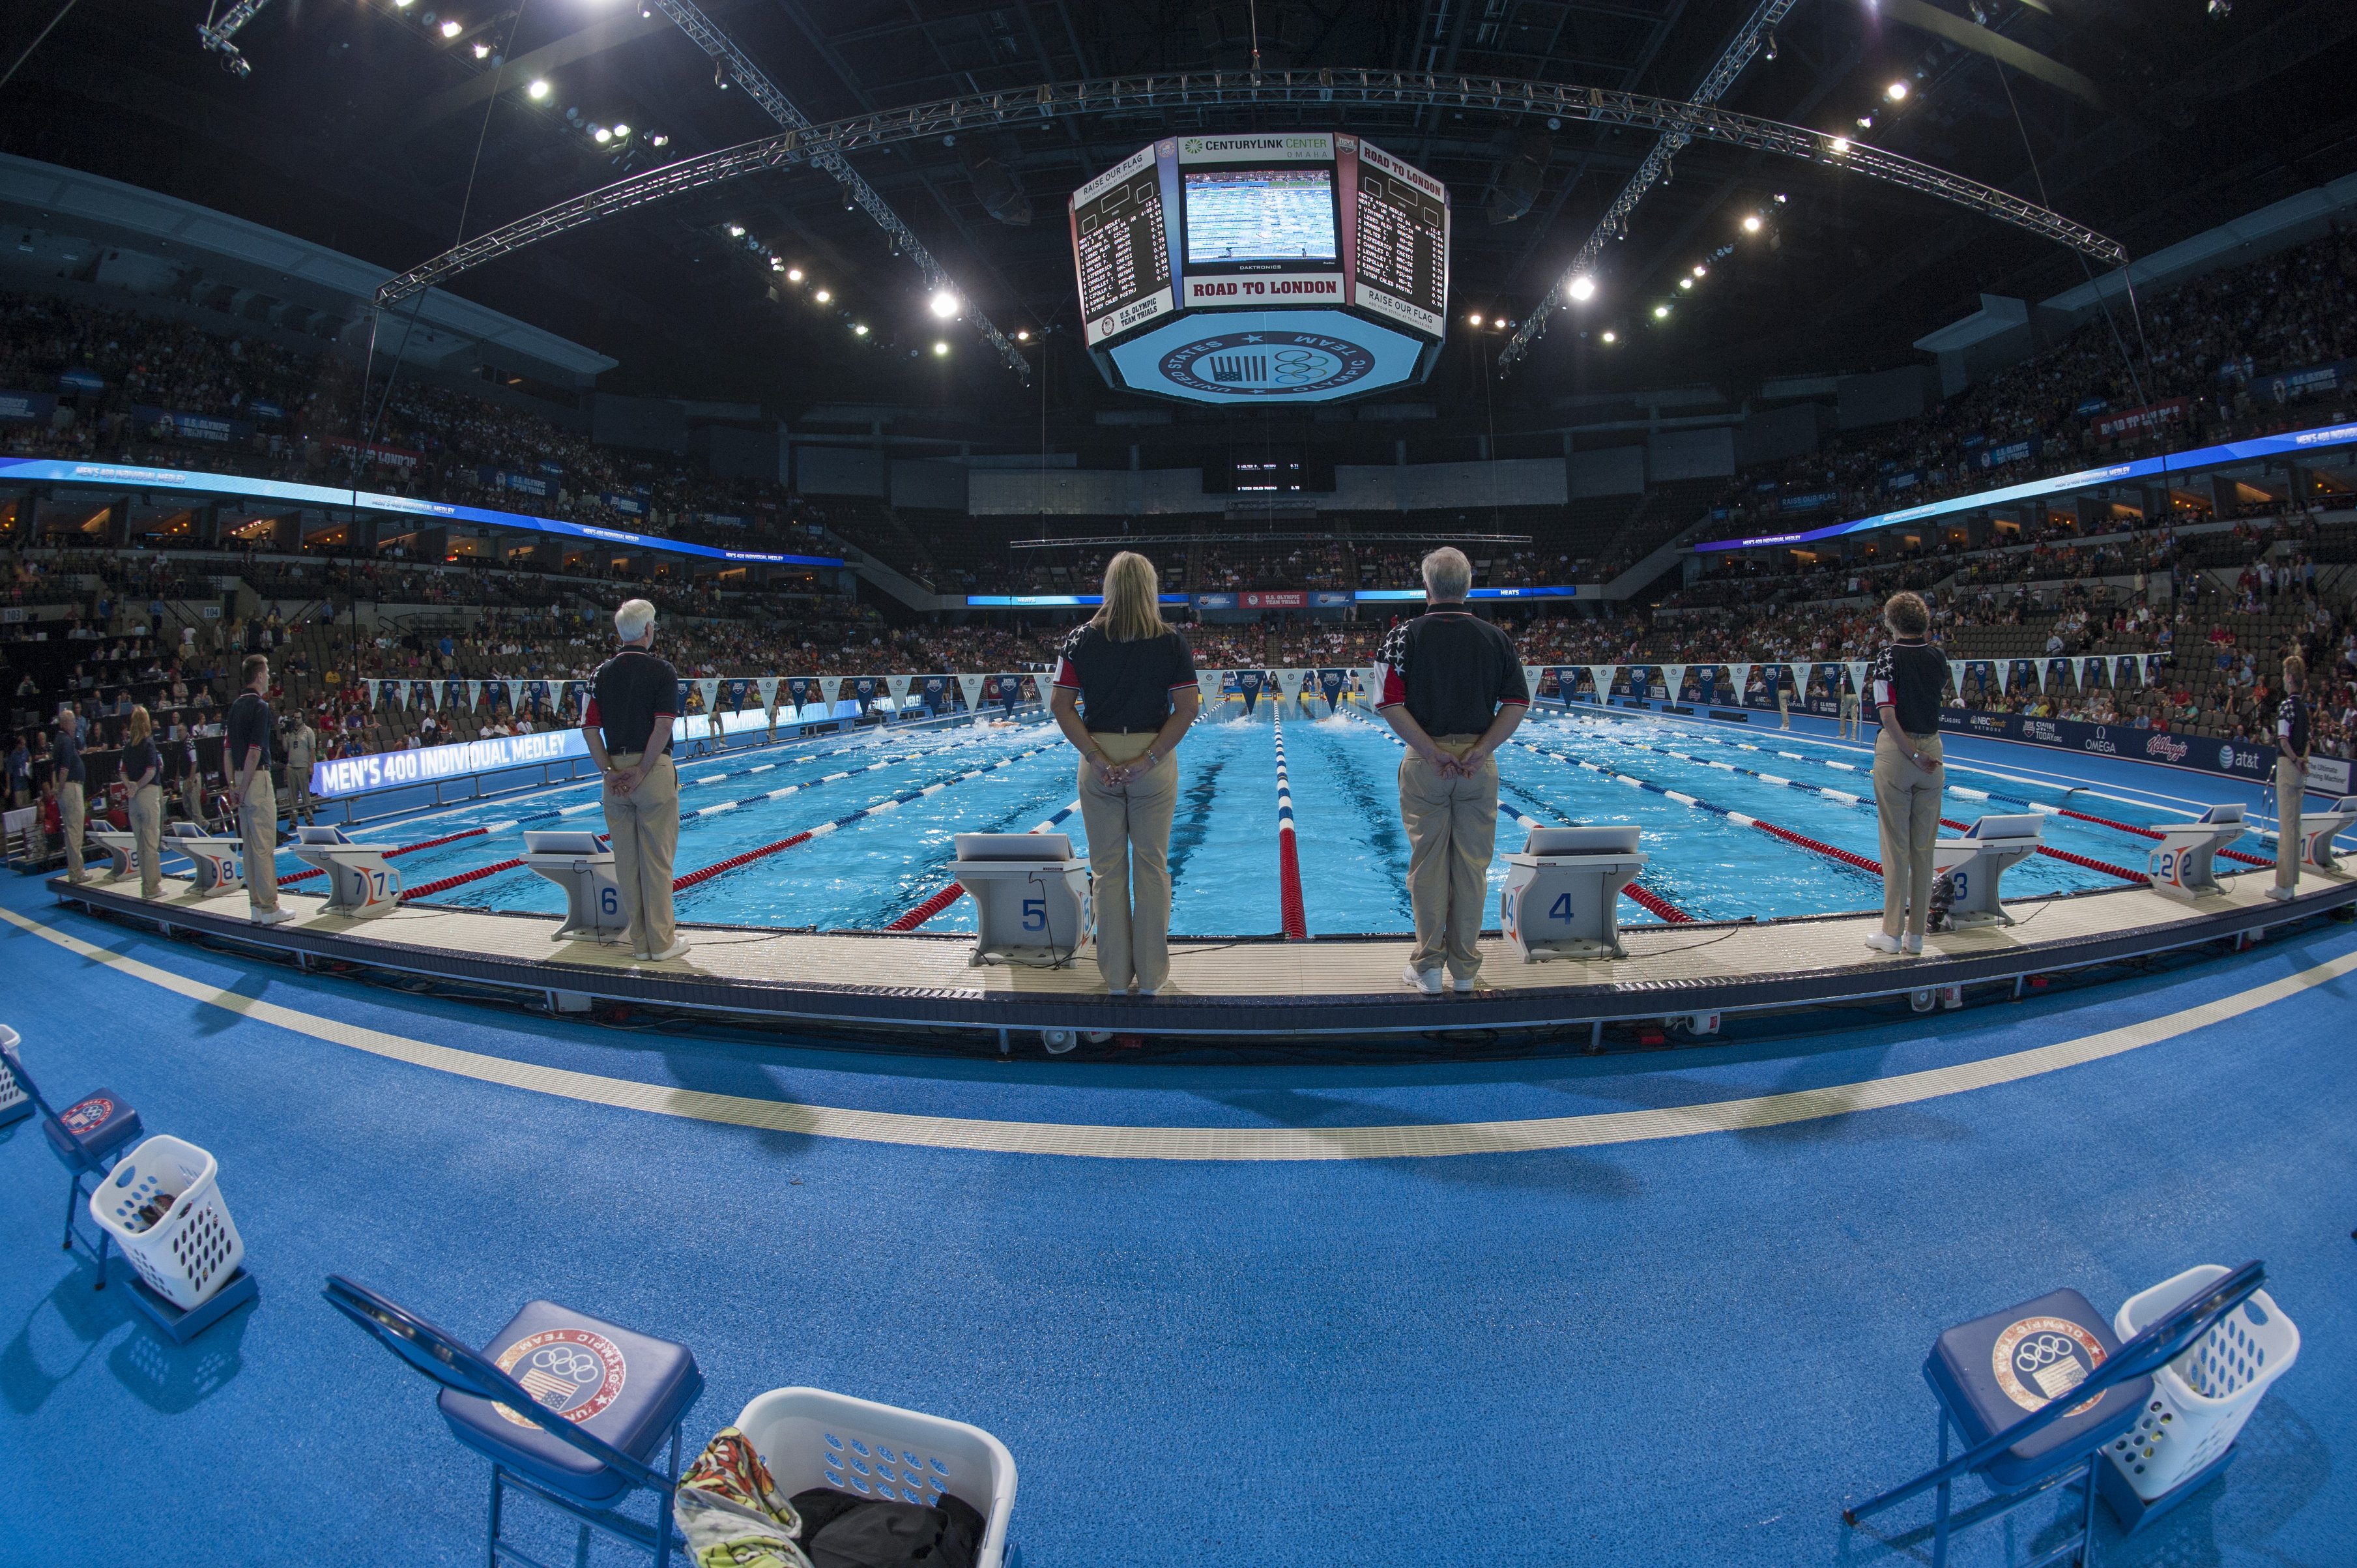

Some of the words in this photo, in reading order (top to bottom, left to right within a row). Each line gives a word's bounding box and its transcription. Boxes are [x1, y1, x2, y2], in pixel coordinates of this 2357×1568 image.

[1286, 138, 1327, 149] CENTER
[1083, 177, 1103, 195] RAISE
[1106, 168, 1121, 181] OUR
[1123, 154, 1142, 171] FLAG
[1365, 147, 1389, 168] ROAD
[1392, 161, 1404, 177] TO
[1407, 169, 1441, 197] LONDON
[1358, 197, 1370, 207] HEAT
[1358, 191, 1373, 202] MEN'S
[1389, 206, 1406, 218] MEDLEY
[1381, 221, 1392, 231] ALEX
[1193, 283, 1237, 297] ROAD
[1243, 282, 1264, 295] TO
[1270, 281, 1337, 293] LONDON
[1120, 310, 1131, 319] U.S.
[1132, 297, 1157, 314] OLYMPIC
[1121, 316, 1136, 327] TEAM
[1137, 306, 1157, 320] TRIALS
[1369, 290, 1393, 307] RAISE
[1395, 301, 1411, 315] OUR
[1413, 309, 1432, 323] FLAG
[1168, 340, 1223, 370] STATES
[1294, 336, 1357, 356] TEAM
[1171, 371, 1231, 392] UNITED
[1293, 359, 1366, 392] OLYMPIC
[433, 505, 455, 515] MEDLEY
[1782, 496, 1801, 506] RAISE
[1803, 495, 1817, 503] OUR
[1819, 493, 1836, 501] FLAG
[7, 610, 20, 620] 103
[205, 608, 218, 617] 104
[1978, 716, 1990, 725] NBC
[2036, 721, 2055, 733] SWIM
[2085, 739, 2116, 753] OMEGA
[2147, 734, 2188, 761] Kellogg's
[321, 757, 381, 793] MEN'S
[383, 752, 416, 783] 400
[421, 740, 510, 777] INDIVIDUAL
[512, 733, 565, 759] MEDLEY
[2235, 752, 2259, 770] at&t
[2317, 764, 2337, 774] Ultimate
[2300, 838, 2306, 857] 1
[222, 860, 233, 880] 8
[2161, 854, 2173, 878] 2
[2183, 853, 2191, 877] 2
[354, 873, 362, 895] 7
[373, 872, 385, 896] 7
[1953, 872, 1967, 901] 3
[601, 888, 618, 916] 6
[1507, 895, 1513, 926] 4
[1549, 893, 1574, 925] 4
[1022, 899, 1046, 931] 5
[1997, 1337, 2014, 1372] TEAM
[2016, 1320, 2084, 1338] OLYMPIC
[520, 1332, 564, 1351] TEAM
[577, 1333, 620, 1384] OLYMPIC
